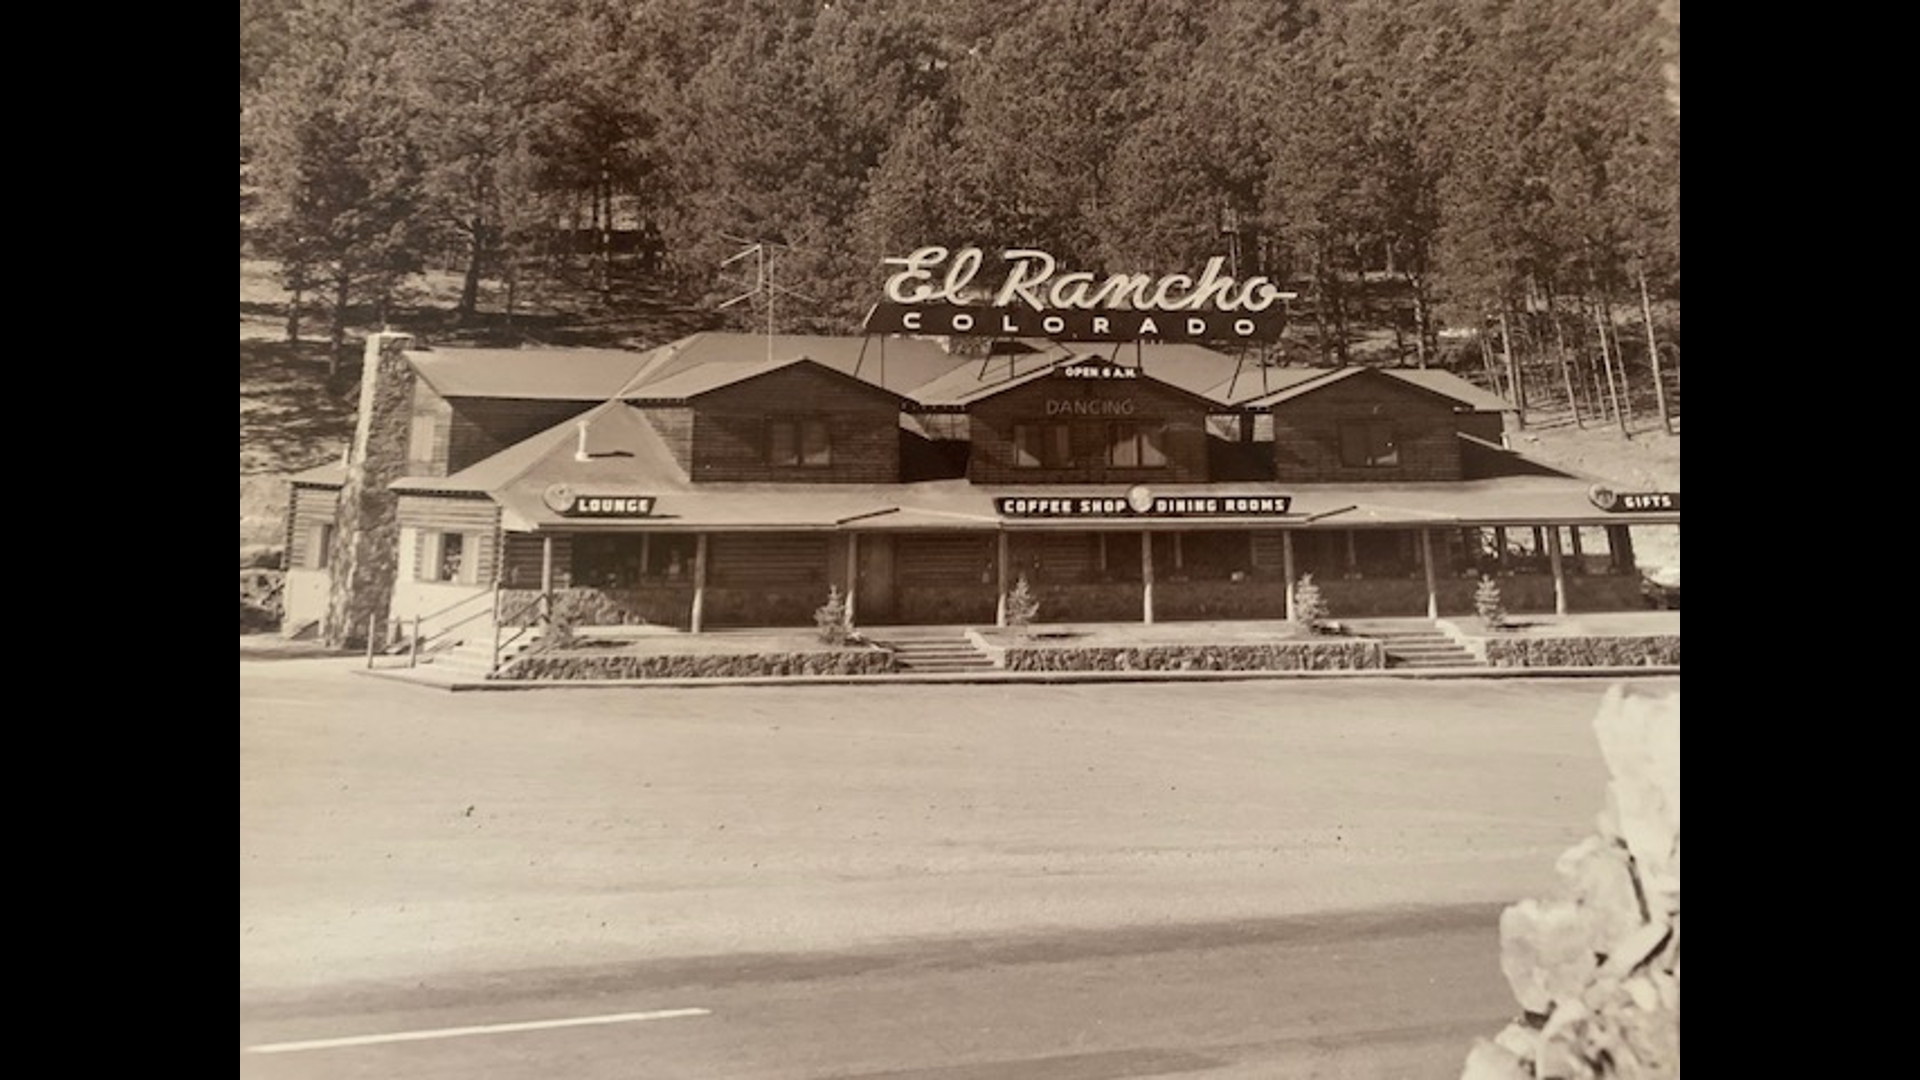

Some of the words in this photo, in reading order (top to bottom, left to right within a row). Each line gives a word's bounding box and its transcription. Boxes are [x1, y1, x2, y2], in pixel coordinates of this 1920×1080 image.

[885, 246, 983, 305] El
[996, 248, 1298, 312] Rancho
[902, 312, 1256, 336] COLORADO
[1065, 366, 1099, 377] OPEN
[1046, 399, 1134, 415] DANCING
[578, 499, 648, 512] LOUNGE
[1003, 499, 1072, 513] COFFEE
[1080, 499, 1127, 513] SHOP
[1156, 498, 1217, 512] DINING
[1225, 498, 1286, 512] ROOMS
[1624, 495, 1672, 508] GIFTS
